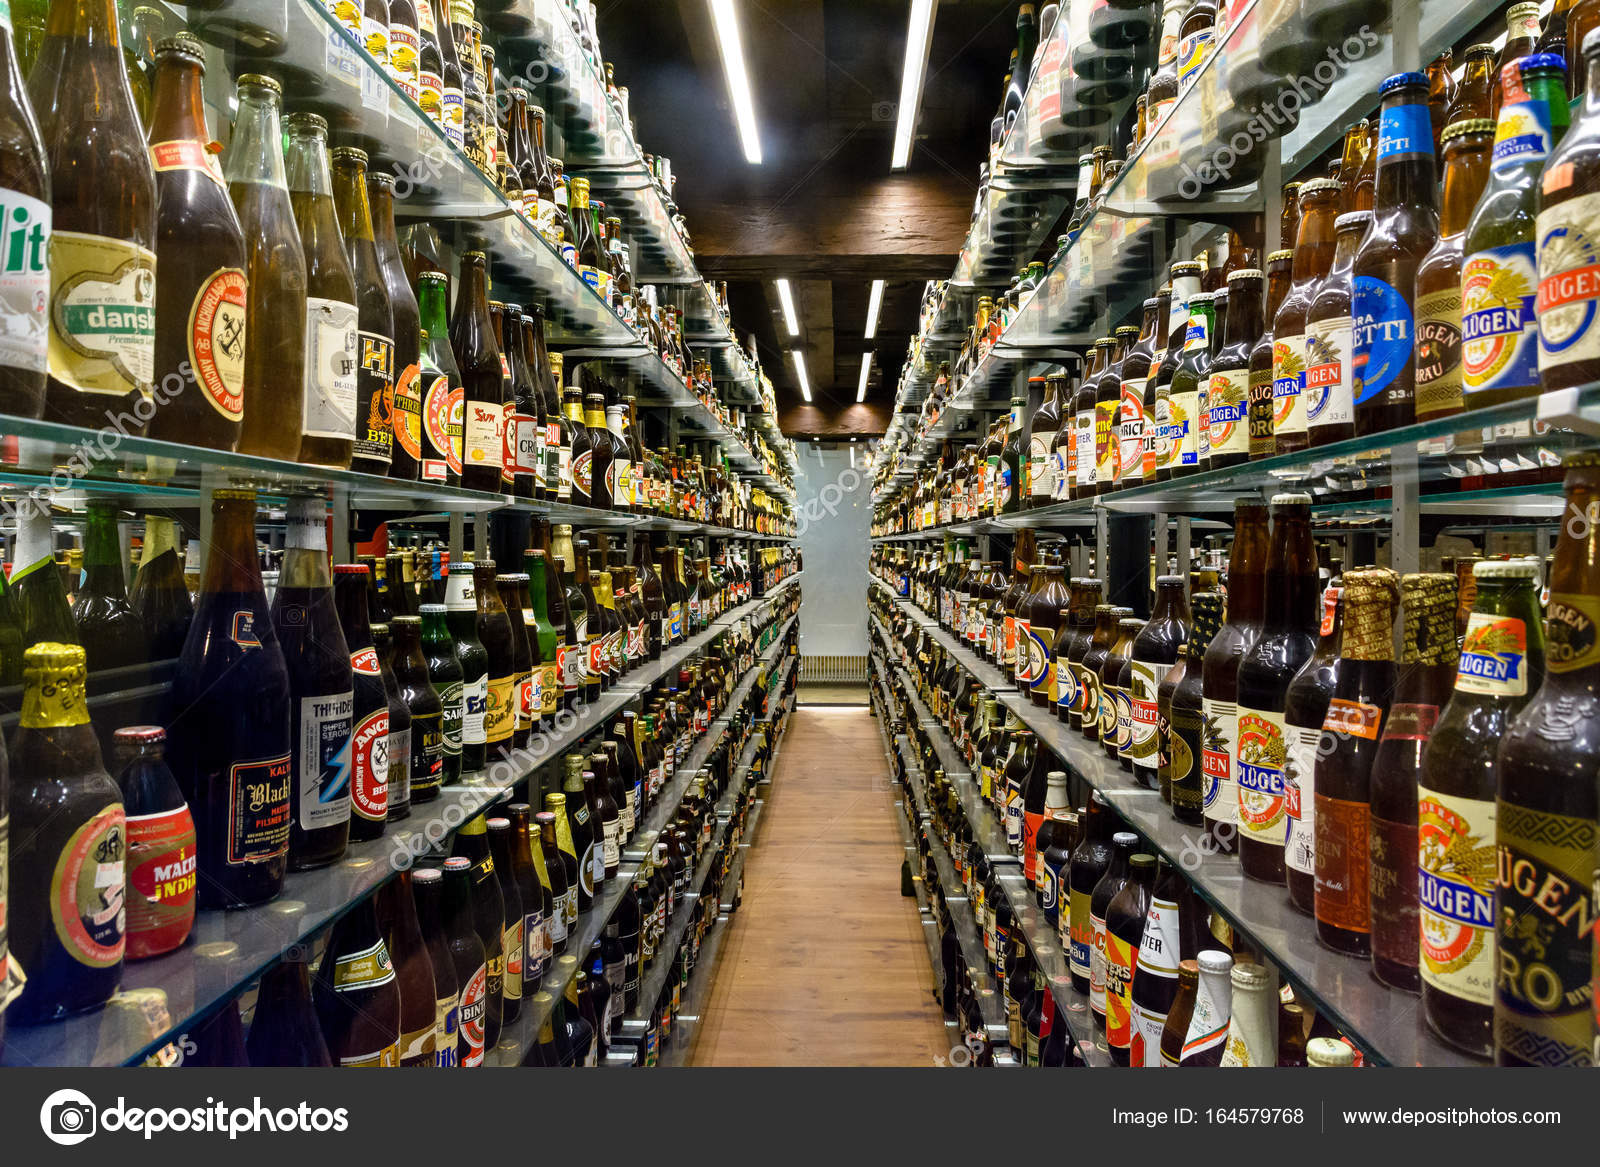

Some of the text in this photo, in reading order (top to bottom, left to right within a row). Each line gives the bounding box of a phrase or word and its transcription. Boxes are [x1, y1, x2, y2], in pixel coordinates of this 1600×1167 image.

[0, 205, 45, 272] it
[200, 358, 224, 397] ANCHOR
[1388, 390, 1404, 399] 33
[1329, 412, 1339, 420] 33
[322, 721, 347, 732] SUPER
[322, 728, 350, 740] STRONG
[351, 961, 373, 972] Extra
[1466, 974, 1480, 986] 66
